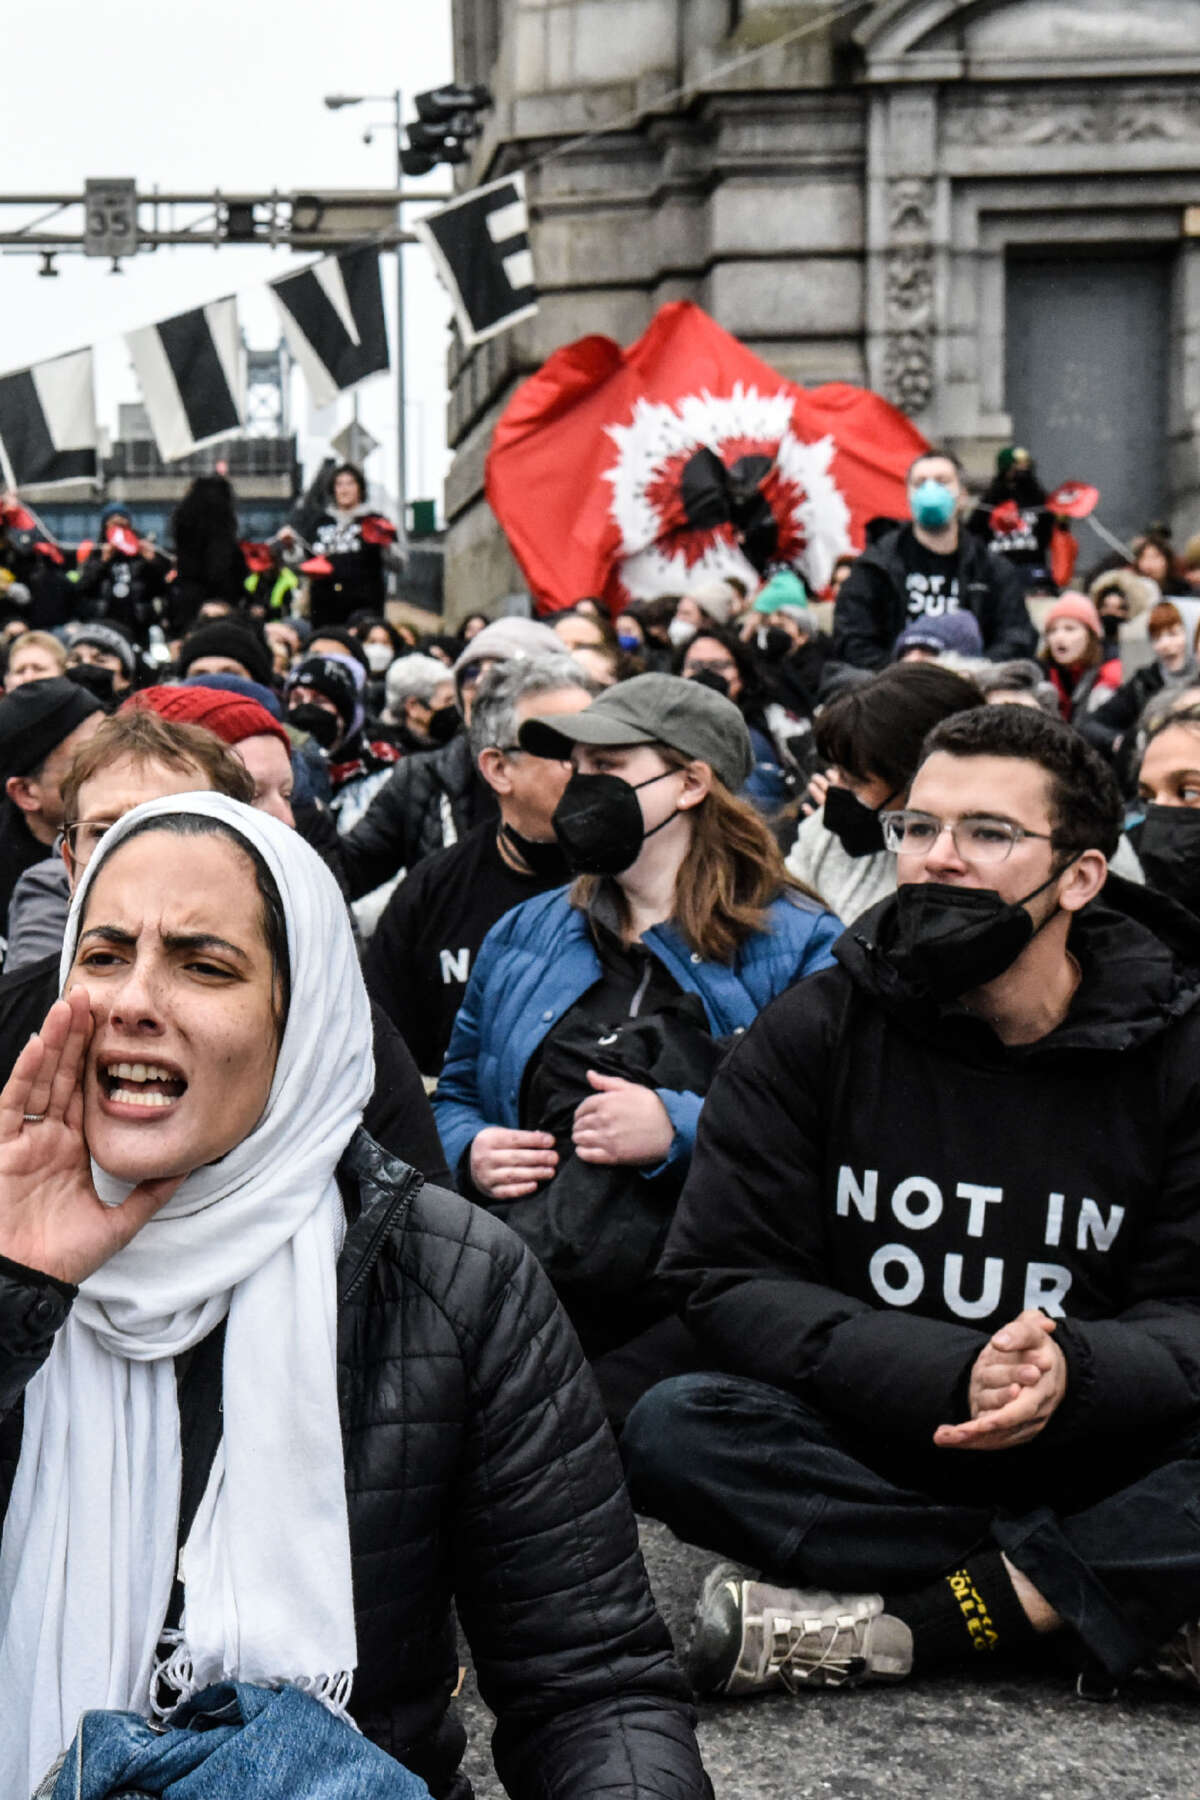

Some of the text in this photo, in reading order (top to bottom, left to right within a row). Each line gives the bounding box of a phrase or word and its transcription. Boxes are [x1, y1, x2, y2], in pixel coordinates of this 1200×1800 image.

[836, 1165, 1125, 1252] NOT IN
[869, 1243, 1073, 1319] OUR
